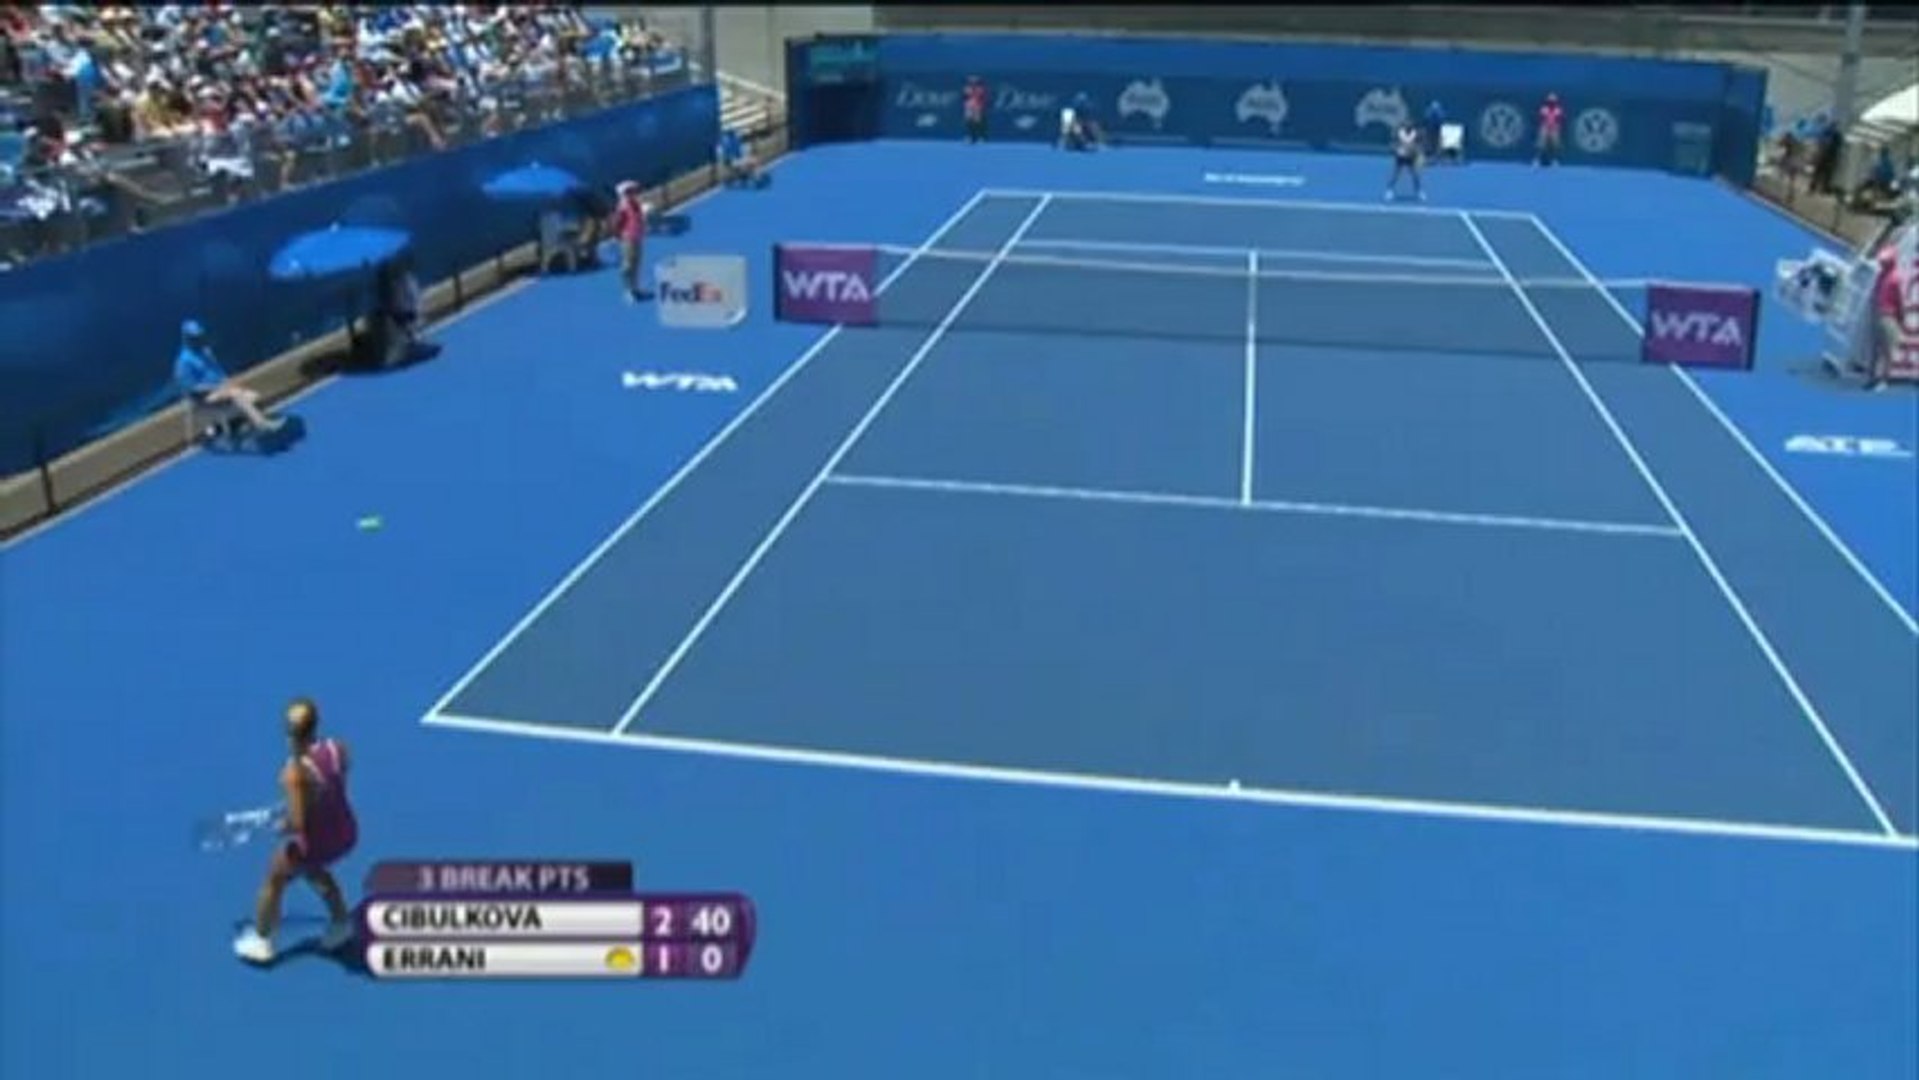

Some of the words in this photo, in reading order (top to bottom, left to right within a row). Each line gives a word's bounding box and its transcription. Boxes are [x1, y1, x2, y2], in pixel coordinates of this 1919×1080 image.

[660, 281, 723, 302] FedEx
[783, 269, 870, 301] WTA
[1651, 311, 1743, 346] WTA
